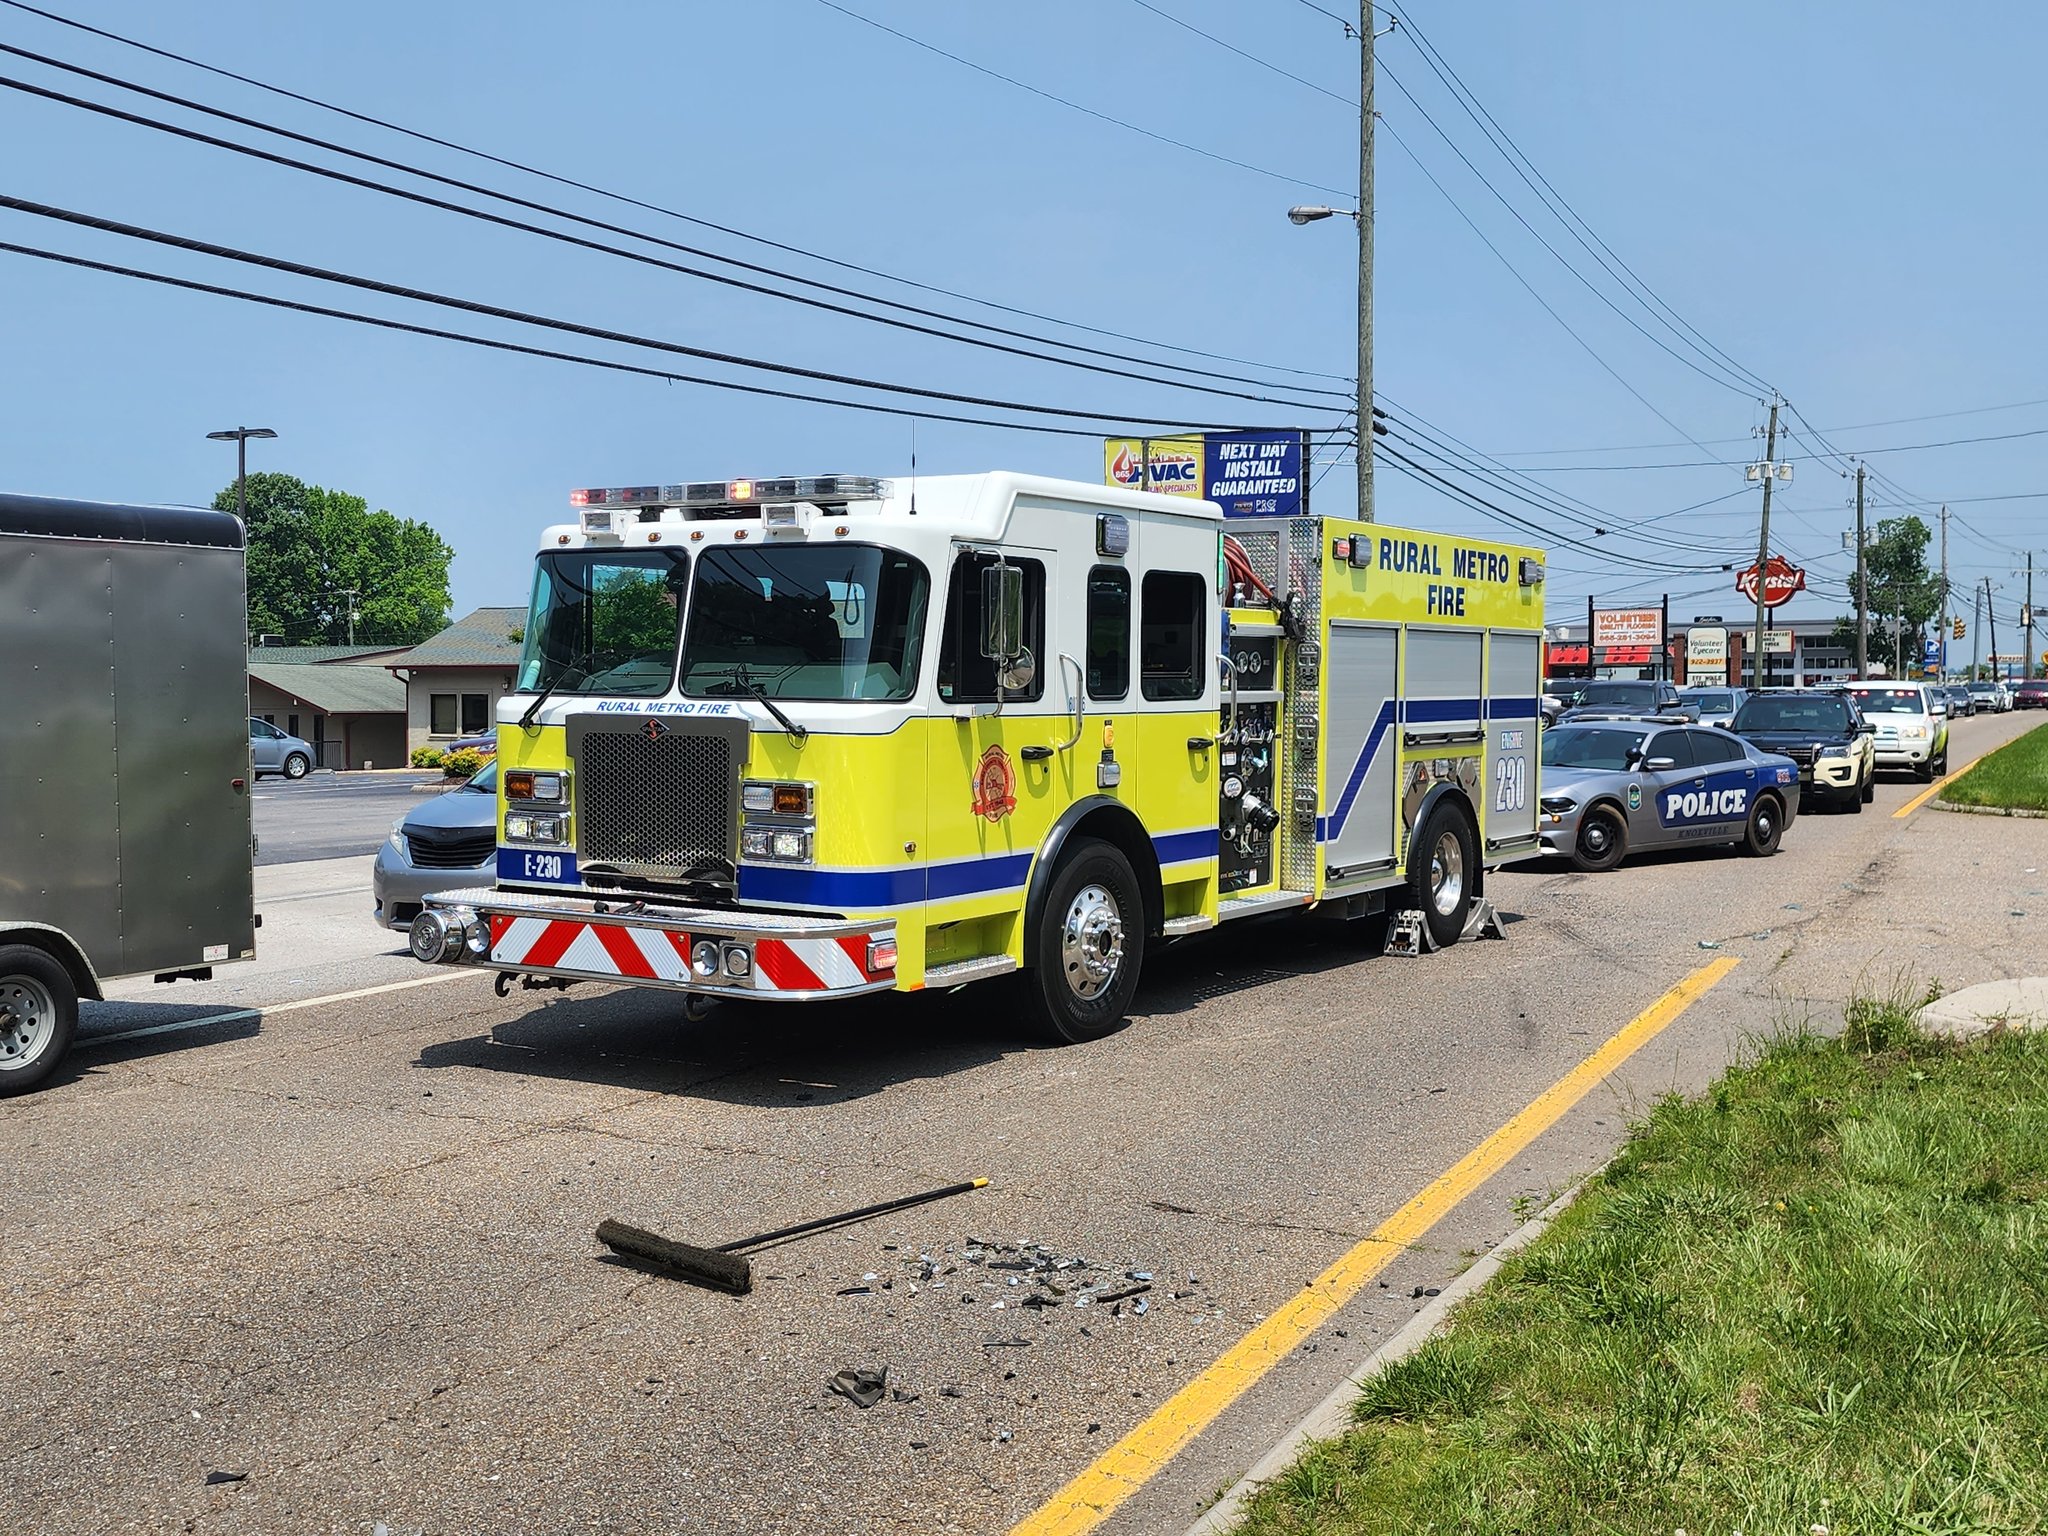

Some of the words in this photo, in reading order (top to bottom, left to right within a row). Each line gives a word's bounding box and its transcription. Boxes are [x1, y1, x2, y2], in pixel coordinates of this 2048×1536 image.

[1219, 443, 1257, 460] NEXT
[1260, 440, 1289, 458] DAY
[1115, 470, 1131, 479] 865
[1225, 460, 1282, 478] INSTALL
[1164, 483, 1198, 494] SPECIALISTS
[1211, 478, 1297, 497] GUARANTEED
[1379, 538, 1442, 576] RURAL
[1453, 548, 1509, 584] METRO
[1427, 584, 1466, 617] FIRE
[1600, 613, 1657, 623] VOLUNTEER
[1692, 647, 1721, 655] Eyecare
[596, 701, 641, 712] RURAL
[645, 702, 696, 713] METRO
[697, 703, 732, 715] FIRE
[1501, 731, 1523, 750] ENGINE
[1496, 756, 1526, 812] 230
[1666, 789, 1746, 820] POLICE
[1677, 825, 1729, 839] KNOXVILLE
[524, 854, 562, 879] E-230
